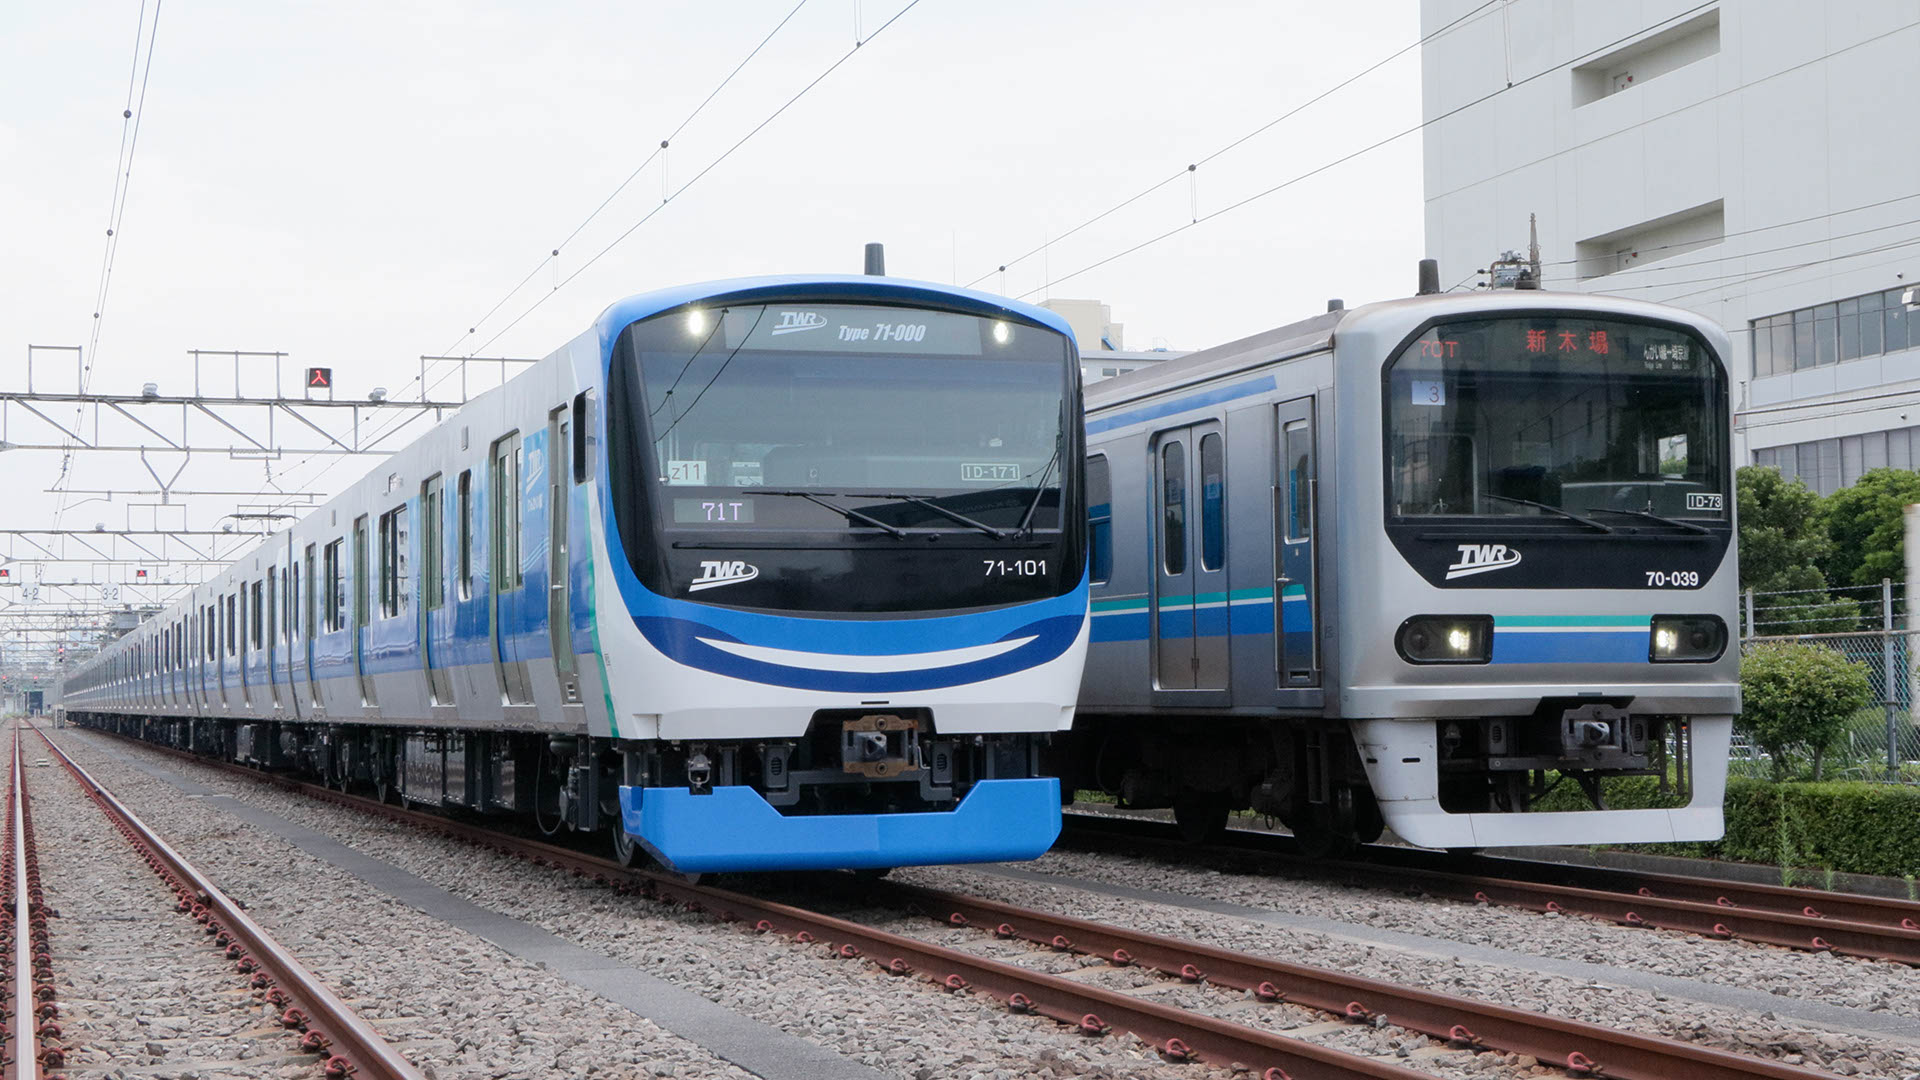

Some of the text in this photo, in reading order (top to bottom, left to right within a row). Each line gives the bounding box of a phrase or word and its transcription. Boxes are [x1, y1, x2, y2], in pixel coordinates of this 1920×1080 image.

[838, 324, 926, 342] Type 71-000
[1418, 340, 1459, 358] 70T
[1526, 329, 1608, 354] 新木場
[1429, 386, 1440, 403] 3
[966, 466, 1017, 478] ID-171
[1690, 496, 1721, 508] ID-73
[702, 502, 743, 521] 71T
[983, 560, 1046, 576] 71-101
[1645, 571, 1699, 587] 70-039
[22, 587, 39, 600] 4-2
[102, 587, 119, 600] 3-2
